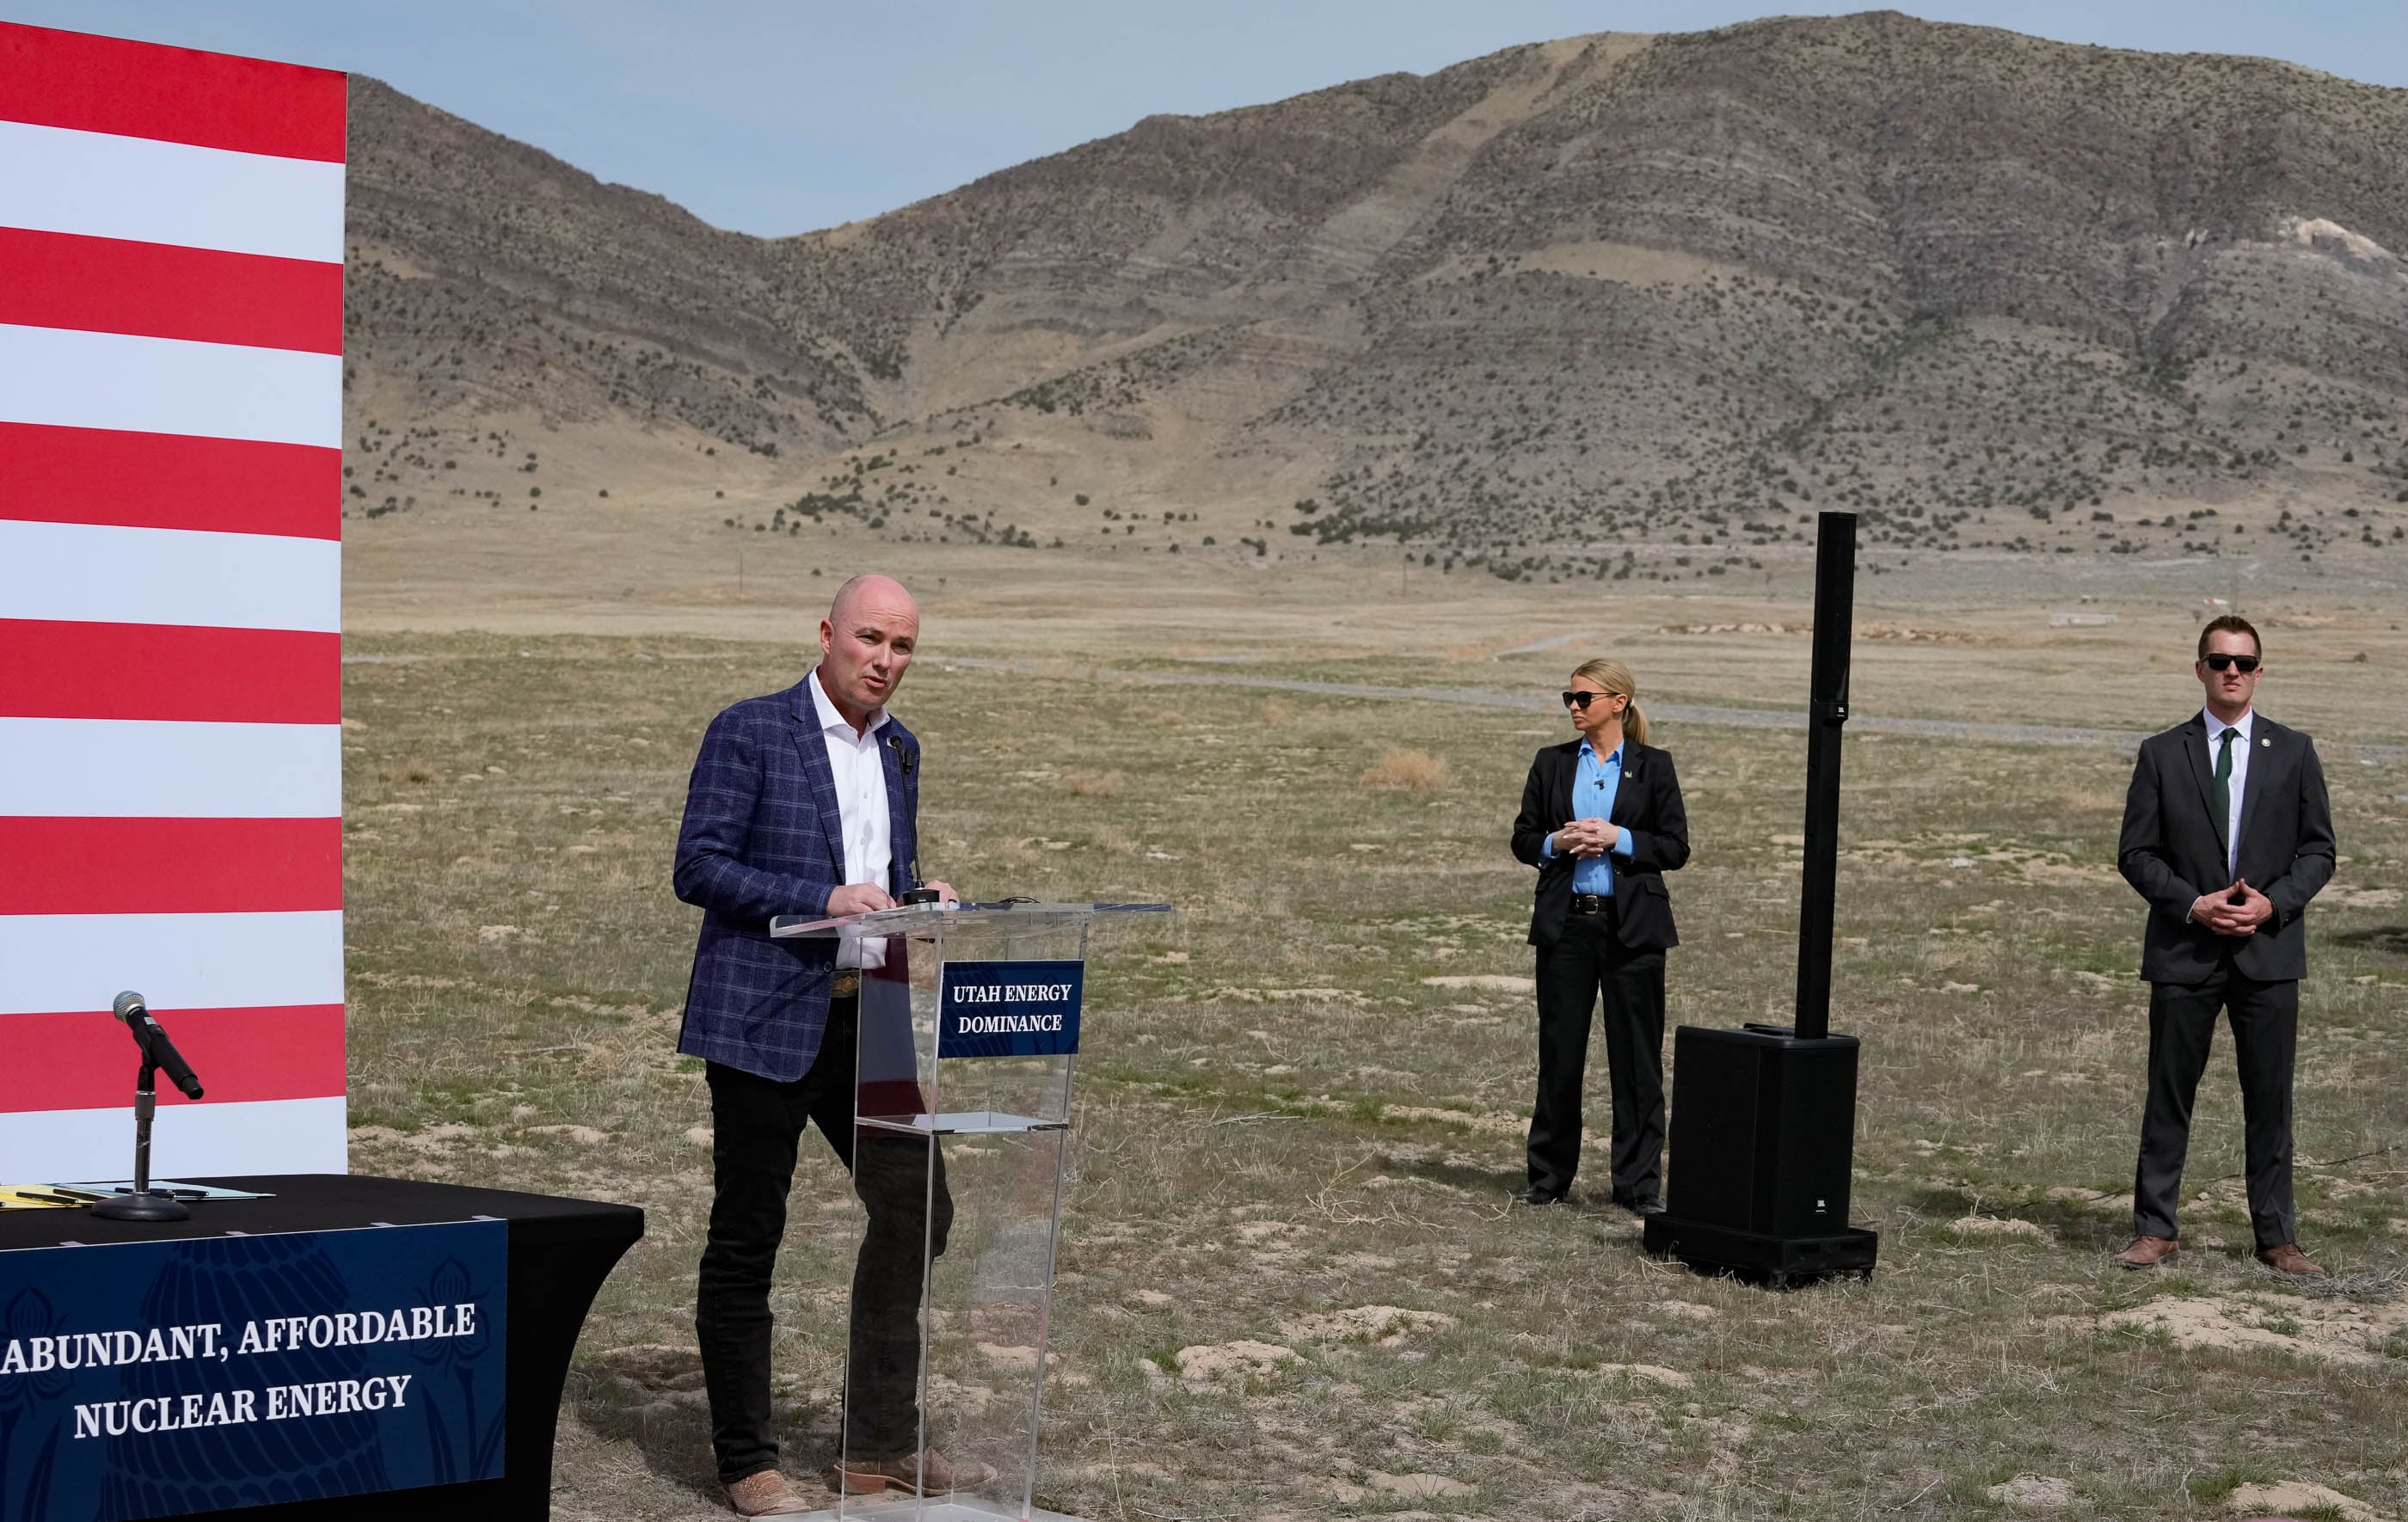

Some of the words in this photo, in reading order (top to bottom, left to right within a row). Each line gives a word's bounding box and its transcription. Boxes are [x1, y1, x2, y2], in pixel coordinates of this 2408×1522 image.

[954, 985, 1001, 1003] UTAH
[1004, 985, 1072, 1001] ENERGY
[959, 1015, 1061, 1033] DOMINANCE
[0, 1324, 229, 1374] ABUNDANT,
[237, 1303, 476, 1355] AFFORDABLE
[74, 1390, 258, 1439] NUCLEAR
[266, 1374, 412, 1421] ENERGY
